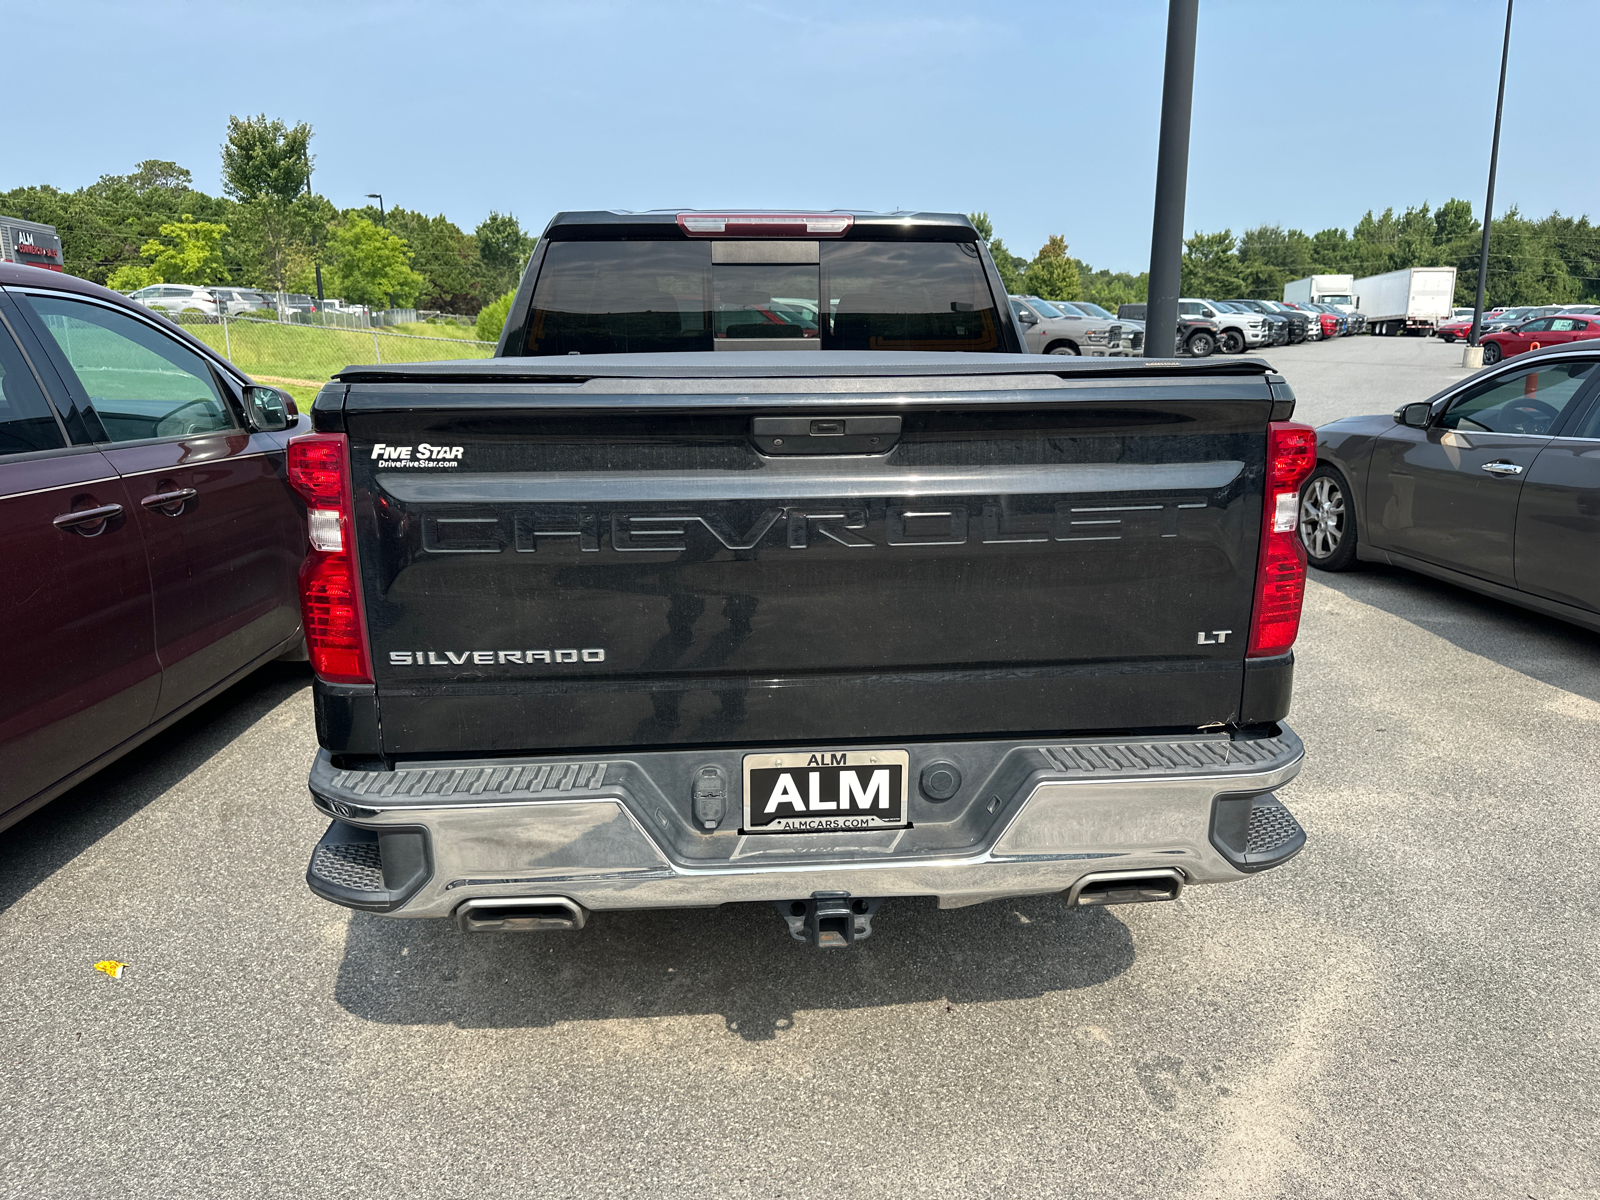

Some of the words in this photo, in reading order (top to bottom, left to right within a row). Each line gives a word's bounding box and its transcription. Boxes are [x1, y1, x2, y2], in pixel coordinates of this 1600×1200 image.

[19, 231, 34, 246] ALM
[371, 444, 413, 459] FIVE
[416, 443, 464, 459] STAR
[378, 460, 458, 468] DriveFiveStar.com
[421, 498, 1208, 554] CHEVROLET
[1197, 630, 1232, 645] LT
[389, 648, 606, 666] SILVERADO
[807, 753, 847, 767] ALM
[764, 769, 890, 814] ALM
[783, 818, 870, 830] ALMCARS.COM
